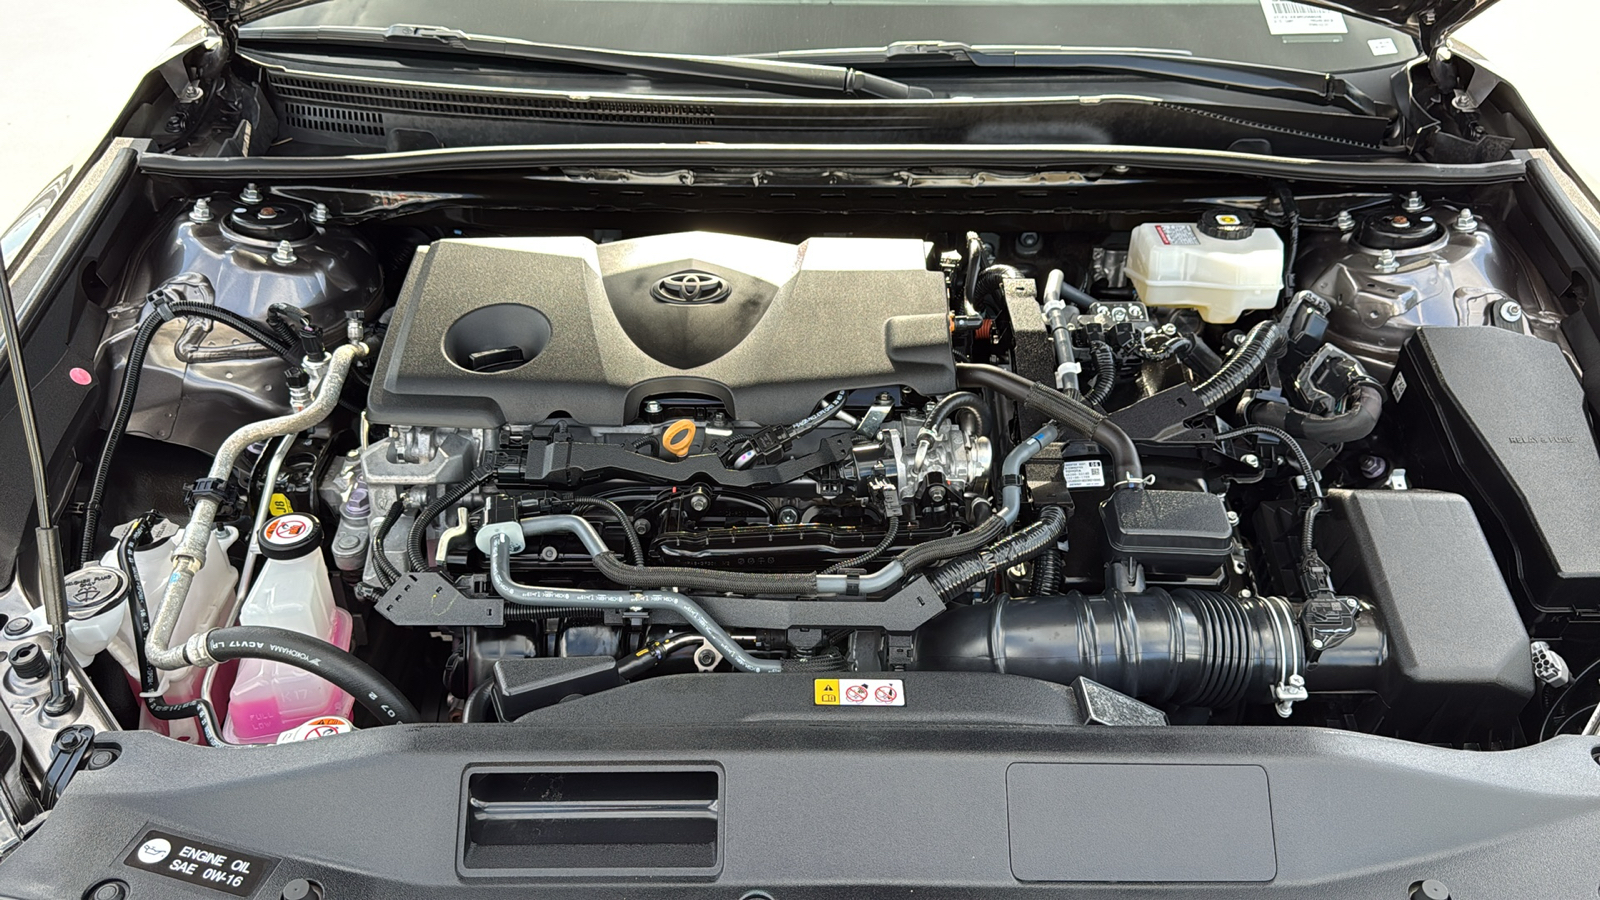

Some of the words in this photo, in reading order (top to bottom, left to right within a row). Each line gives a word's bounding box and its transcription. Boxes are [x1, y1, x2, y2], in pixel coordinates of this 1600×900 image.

[229, 641, 264, 649] ACV17
[269, 643, 310, 661] YOKOHAMA
[178, 845, 227, 867] ENGINE
[230, 859, 250, 874] OIL
[169, 859, 198, 875] SAE
[202, 868, 243, 887] 0W-16
